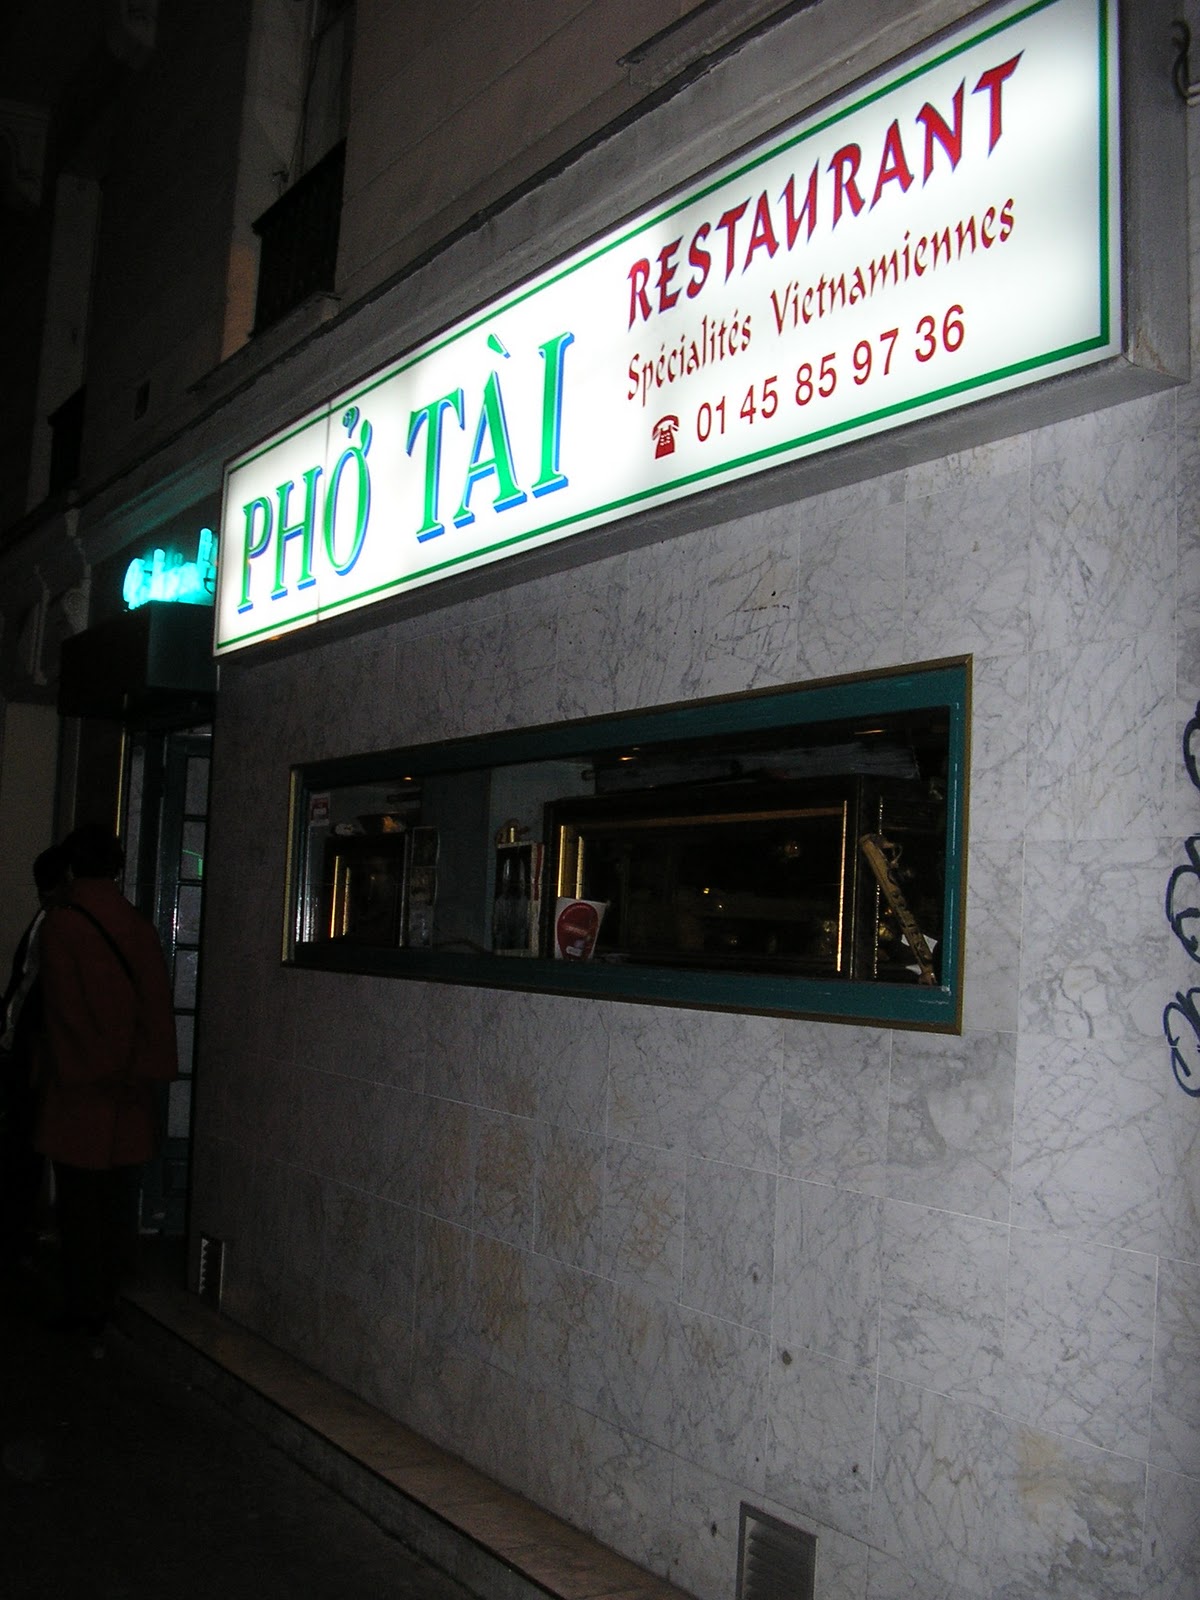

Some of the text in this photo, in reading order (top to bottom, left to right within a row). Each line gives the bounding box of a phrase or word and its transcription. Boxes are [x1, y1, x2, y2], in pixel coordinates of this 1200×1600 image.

[627, 49, 1025, 332] RESTAURANT
[627, 198, 1014, 407] Spécialités Vietnamiennes
[238, 331, 575, 614] PHỞ TÀI
[696, 304, 965, 442] 01 45 85 97 36
